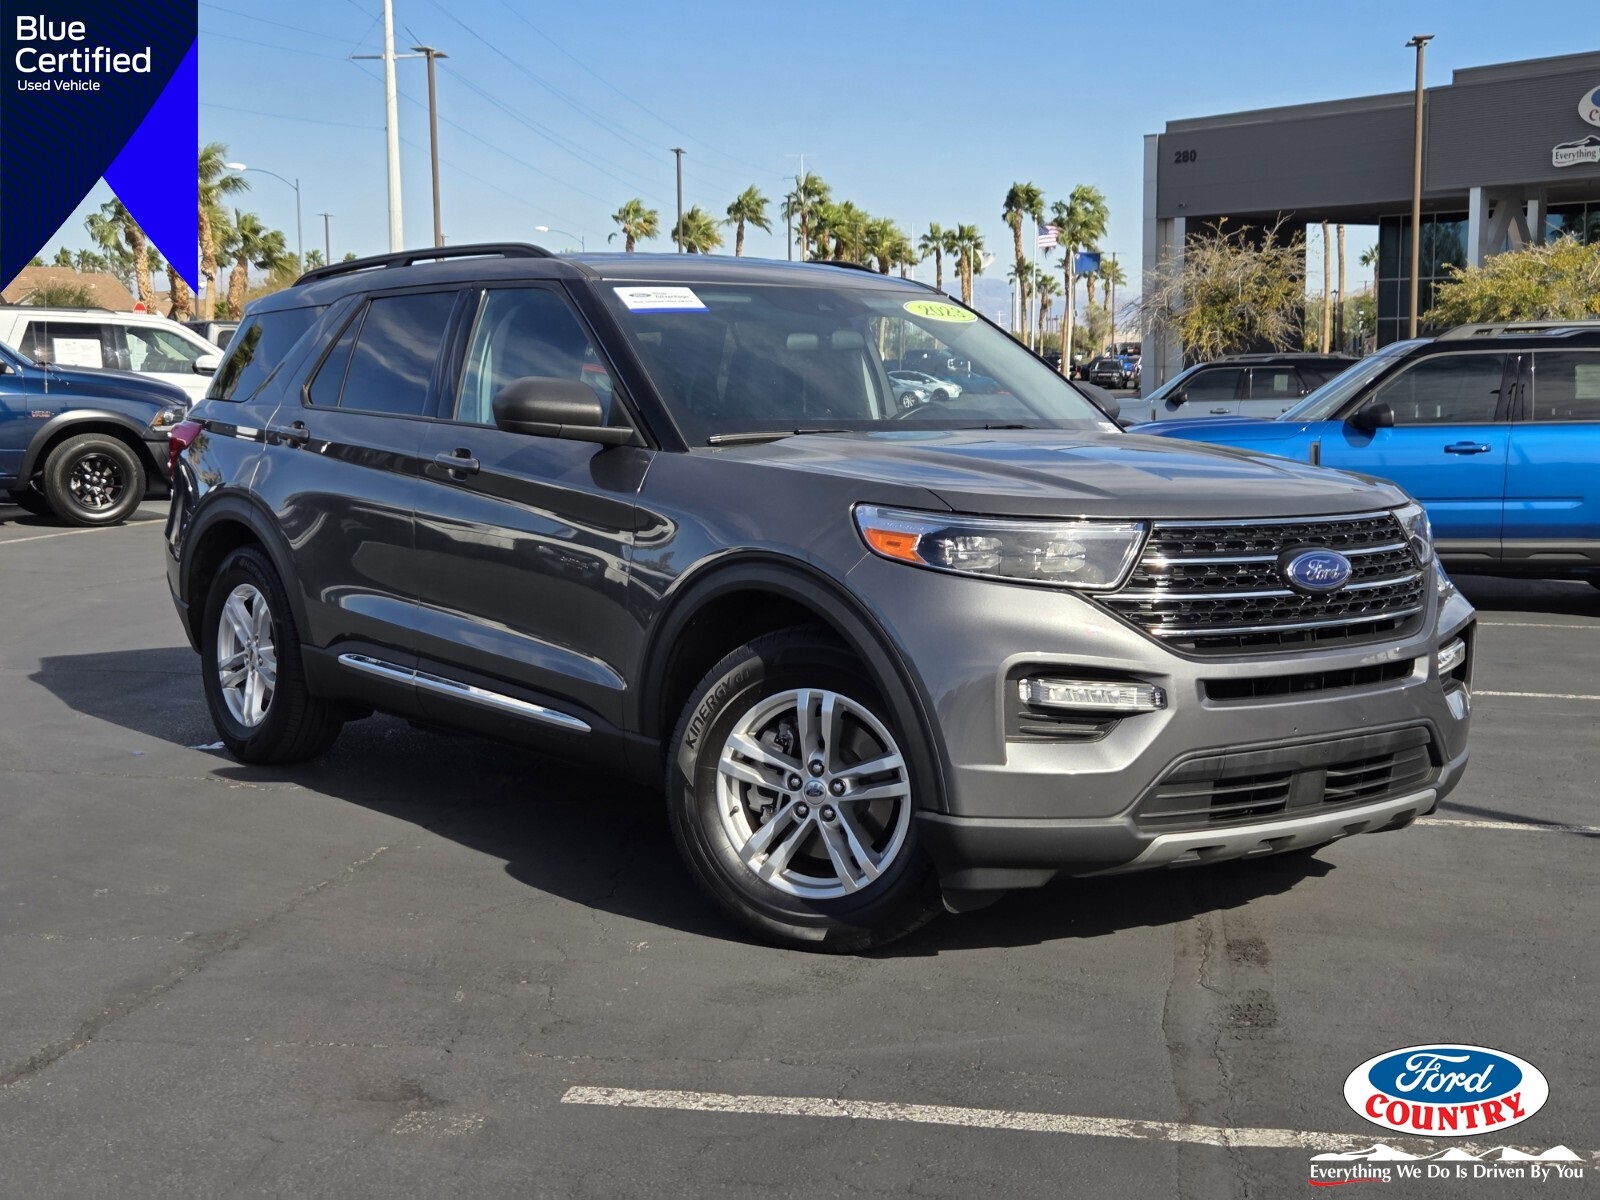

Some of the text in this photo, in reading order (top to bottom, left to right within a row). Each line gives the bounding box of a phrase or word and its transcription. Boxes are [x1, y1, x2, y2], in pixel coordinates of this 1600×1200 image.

[1174, 149, 1197, 164] 280
[1555, 149, 1597, 161] Everything
[1306, 559, 1340, 581] Ford
[685, 677, 731, 749] KINERGY
